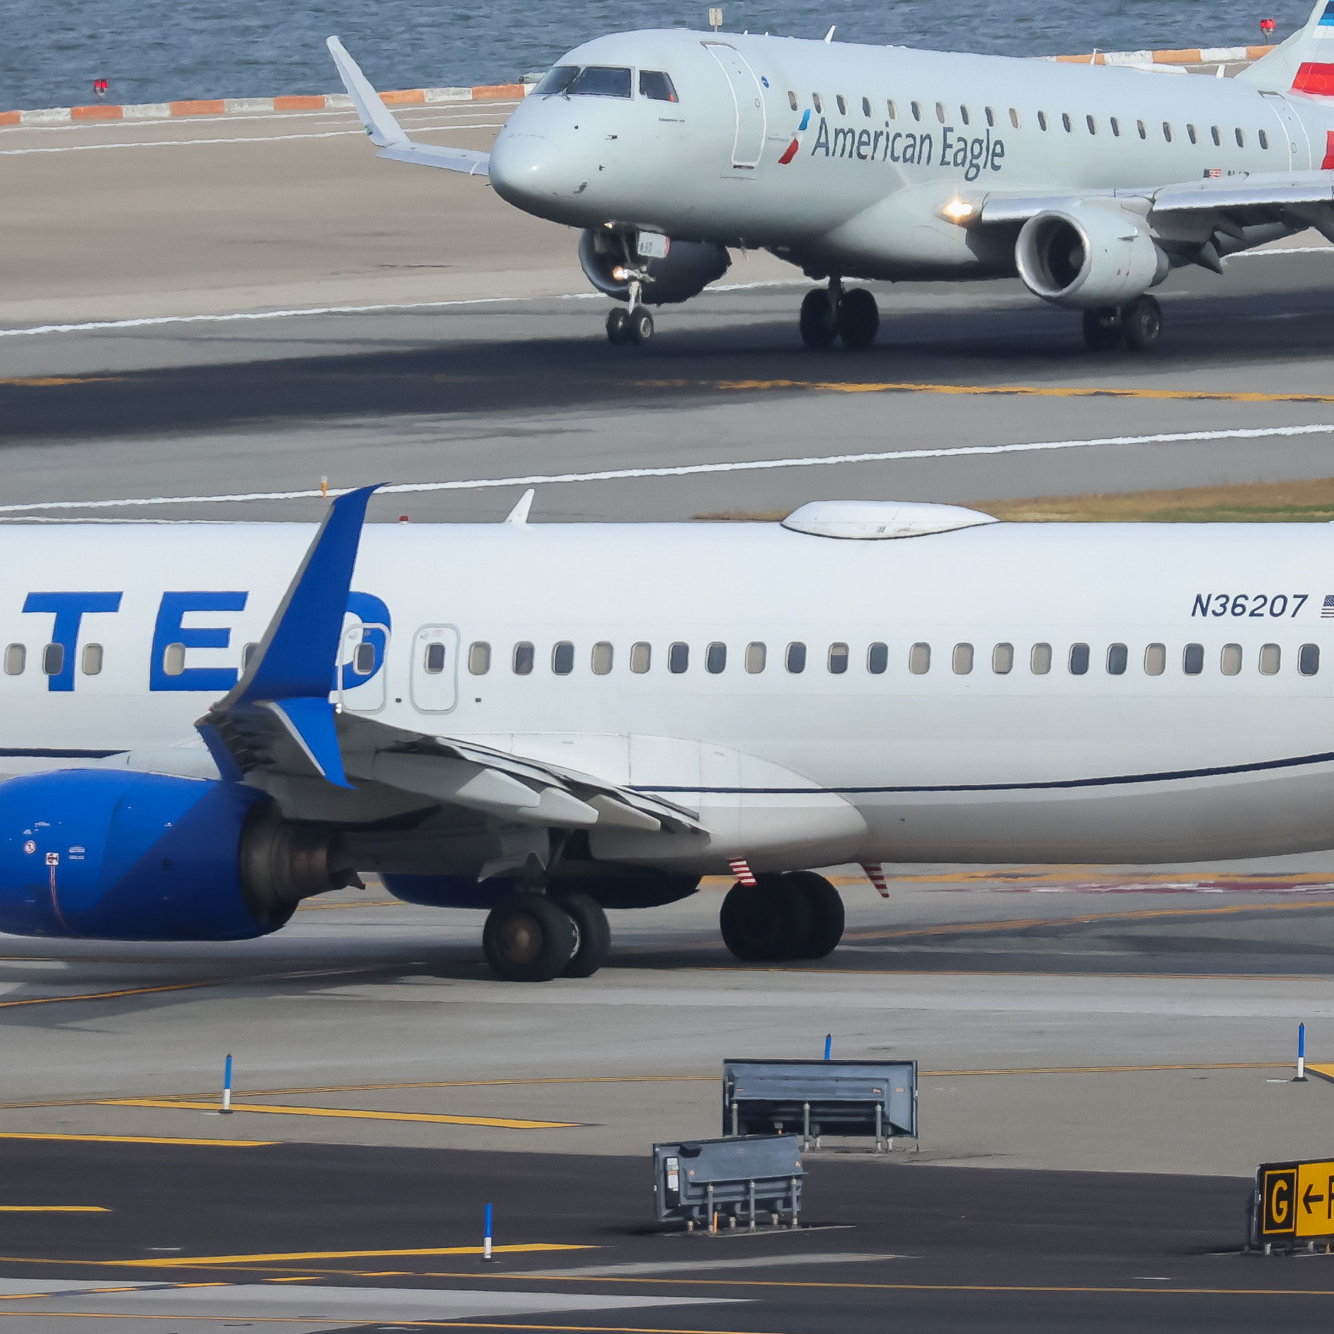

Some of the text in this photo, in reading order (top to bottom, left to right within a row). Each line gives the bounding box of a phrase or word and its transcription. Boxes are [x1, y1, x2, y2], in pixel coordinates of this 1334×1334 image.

[811, 117, 1005, 182] American Eagle
[1191, 594, 1309, 618] N36207
[1272, 1179, 1289, 1223] G
